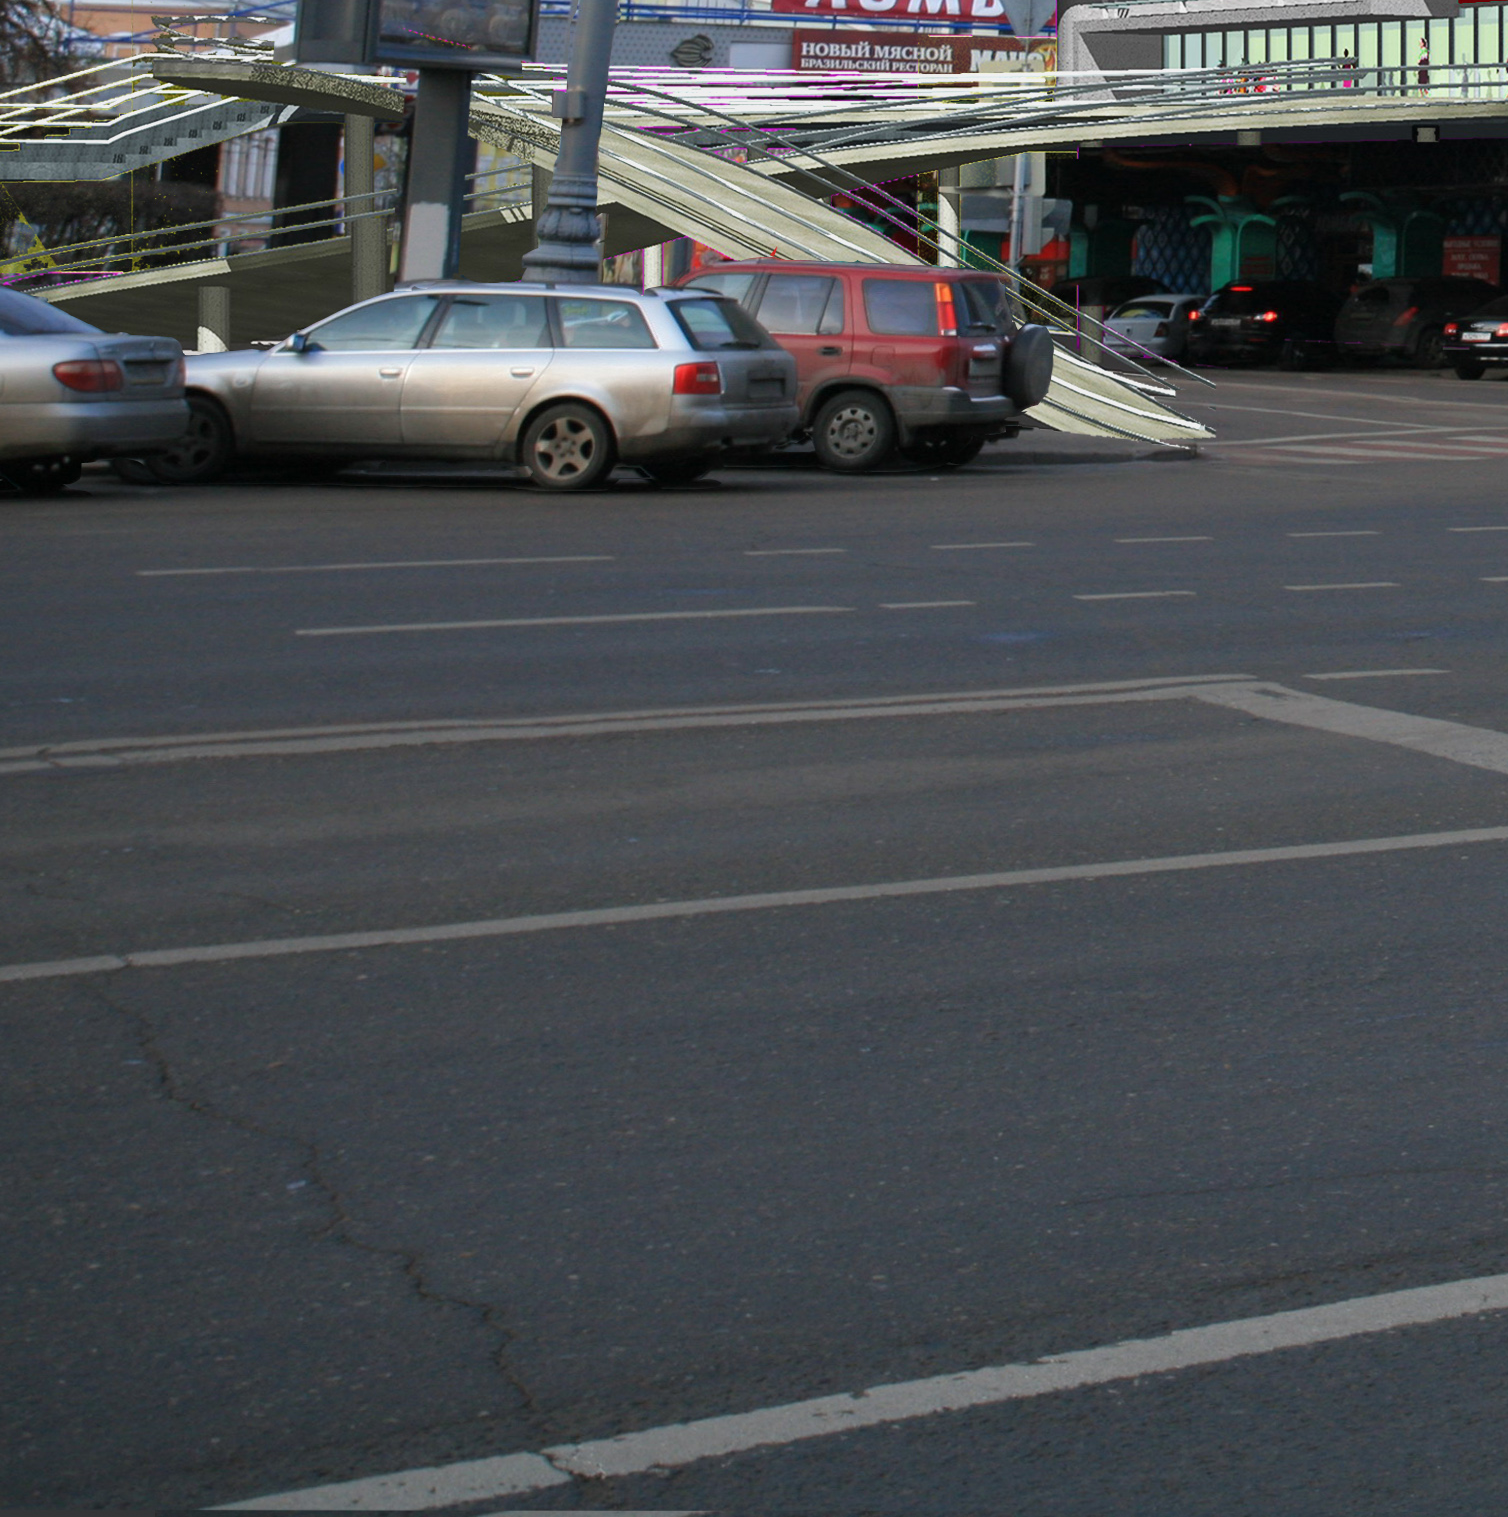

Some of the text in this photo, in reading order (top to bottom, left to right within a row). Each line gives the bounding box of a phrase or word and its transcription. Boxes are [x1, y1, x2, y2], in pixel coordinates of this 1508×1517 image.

[801, 41, 953, 61] НОВЫЙ МЯСНОЙ
[801, 58, 953, 74] БРАЗИЛЬСКИЙ РЕСТОРАН
